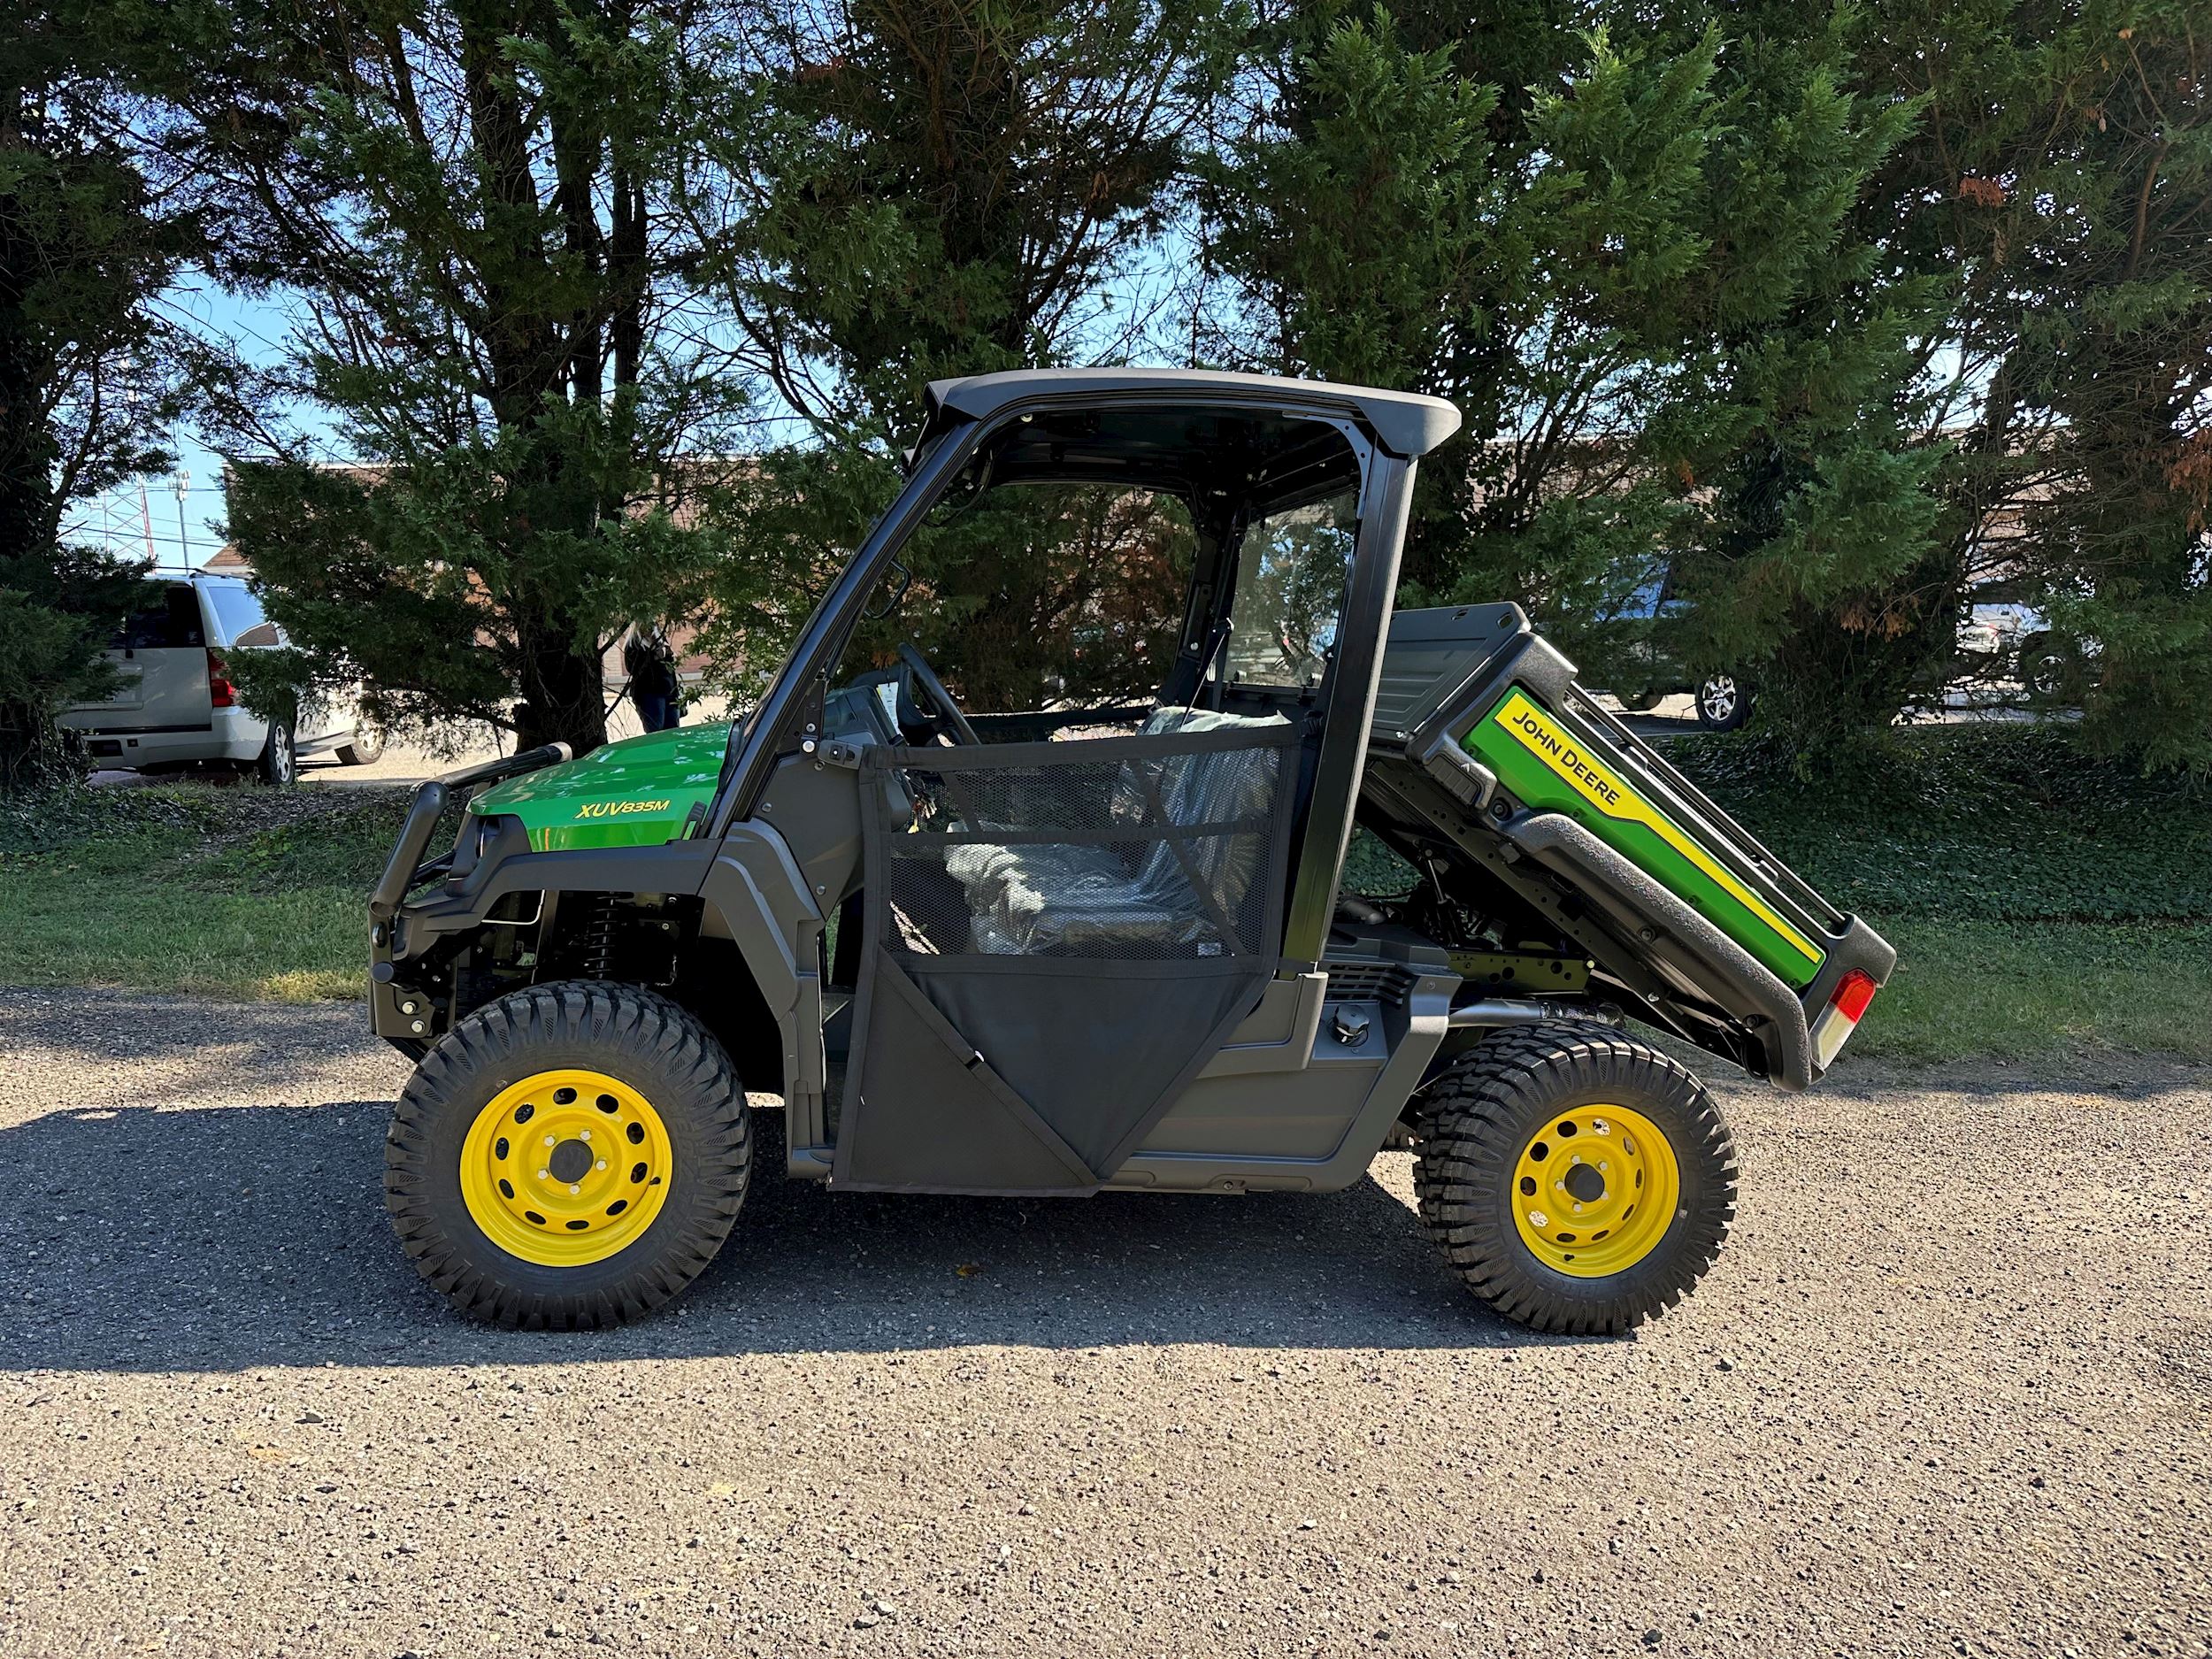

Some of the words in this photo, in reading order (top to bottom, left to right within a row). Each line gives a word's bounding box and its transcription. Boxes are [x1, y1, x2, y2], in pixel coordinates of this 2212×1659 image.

[1512, 711, 1562, 756] JOHN
[1561, 749, 1620, 806] DEERE
[573, 799, 671, 819] XUV835M
